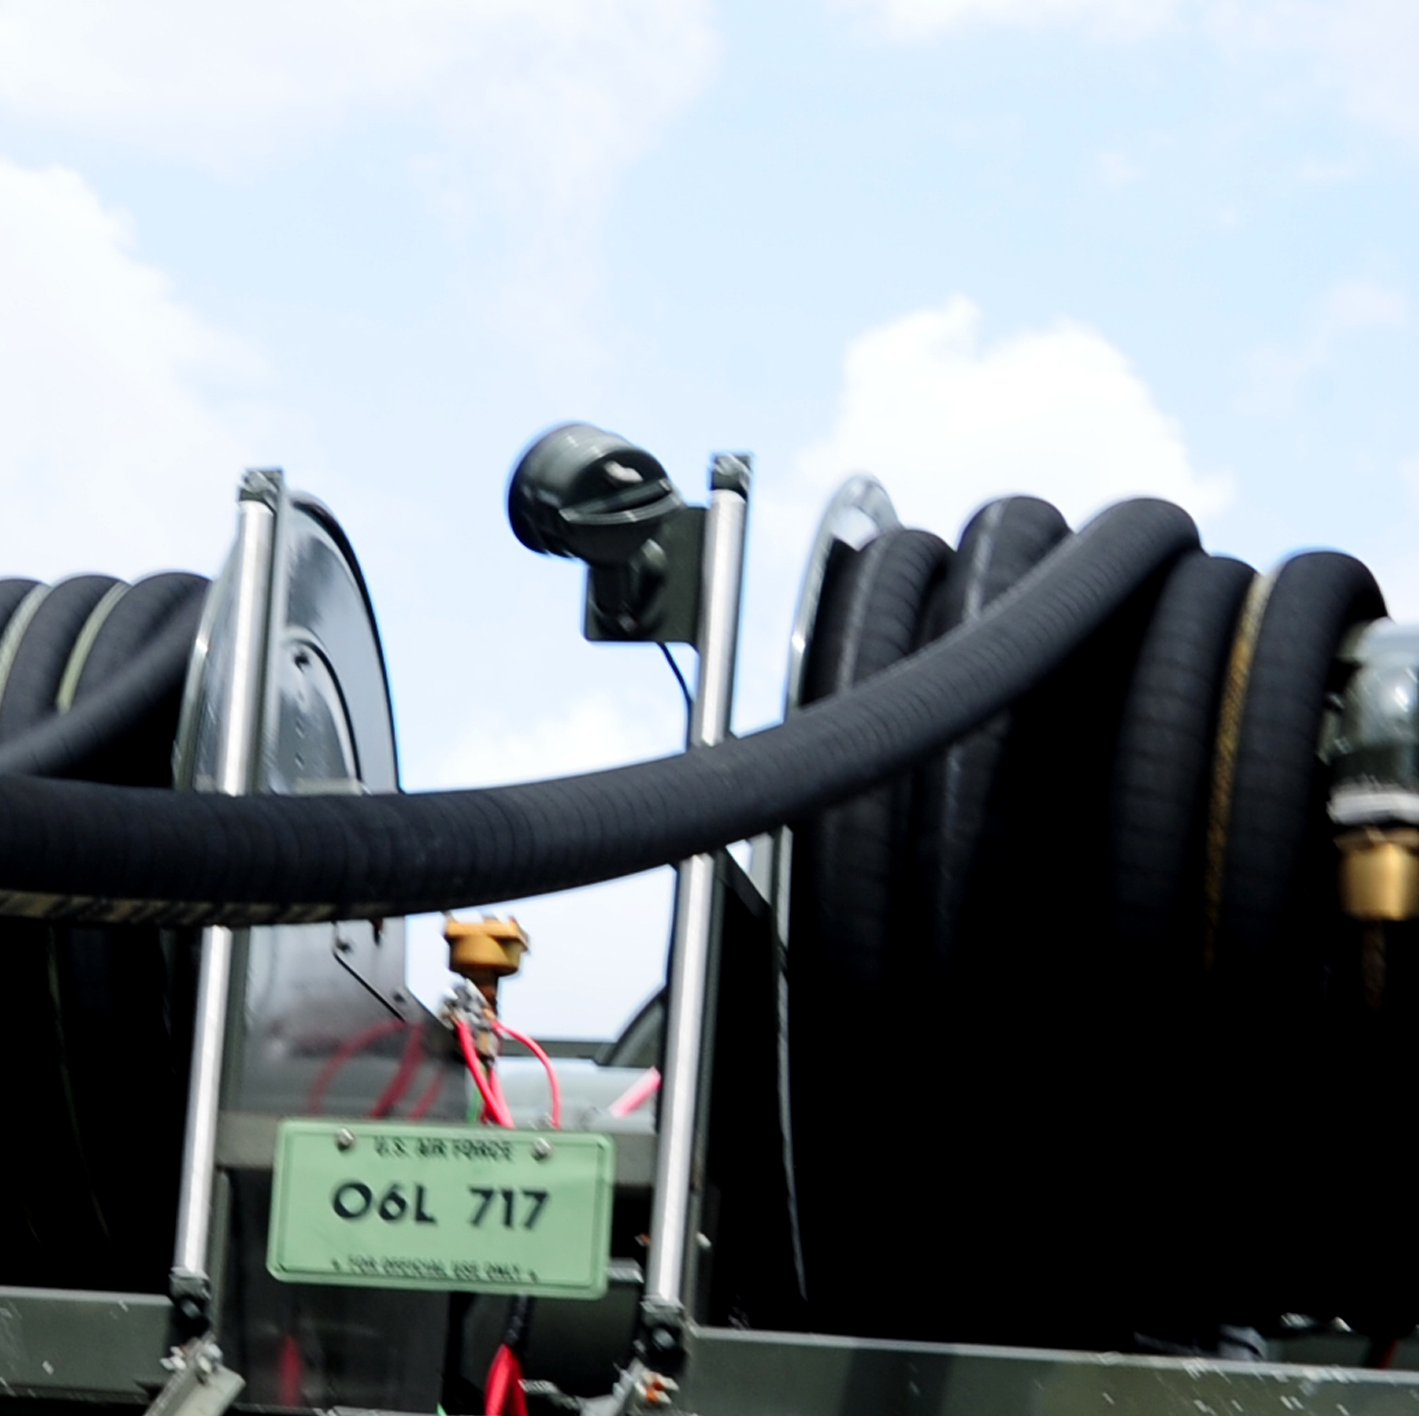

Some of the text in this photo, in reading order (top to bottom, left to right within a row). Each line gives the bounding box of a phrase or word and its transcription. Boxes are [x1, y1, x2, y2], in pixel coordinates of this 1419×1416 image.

[417, 1137, 448, 1159] AIR
[453, 1139, 514, 1163] FORCE
[468, 1185, 551, 1231] 717
